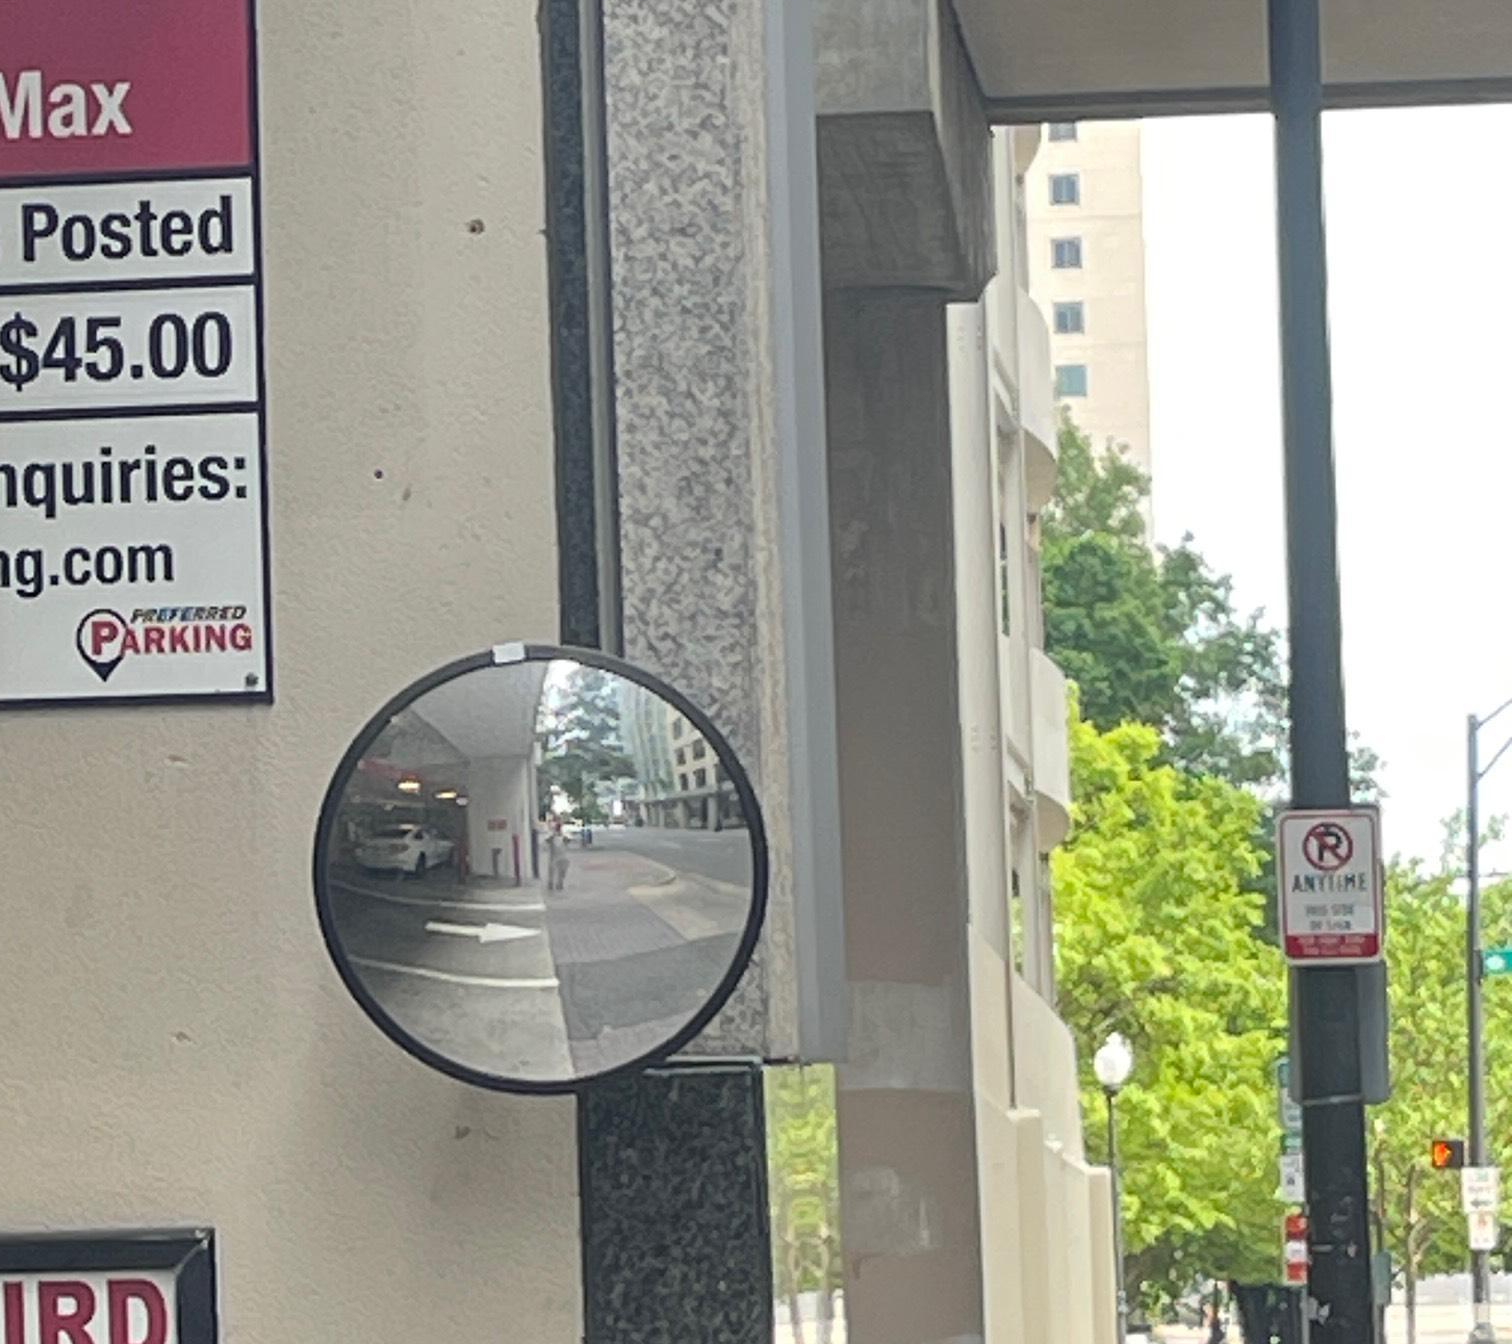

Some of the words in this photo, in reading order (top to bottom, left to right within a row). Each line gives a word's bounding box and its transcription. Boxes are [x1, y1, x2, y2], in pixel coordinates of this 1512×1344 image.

[22, 195, 234, 262] Posted
[131, 606, 247, 623] PREFERRED
[91, 620, 252, 656] PARKING
[1292, 873, 1368, 893] ANYTIME
